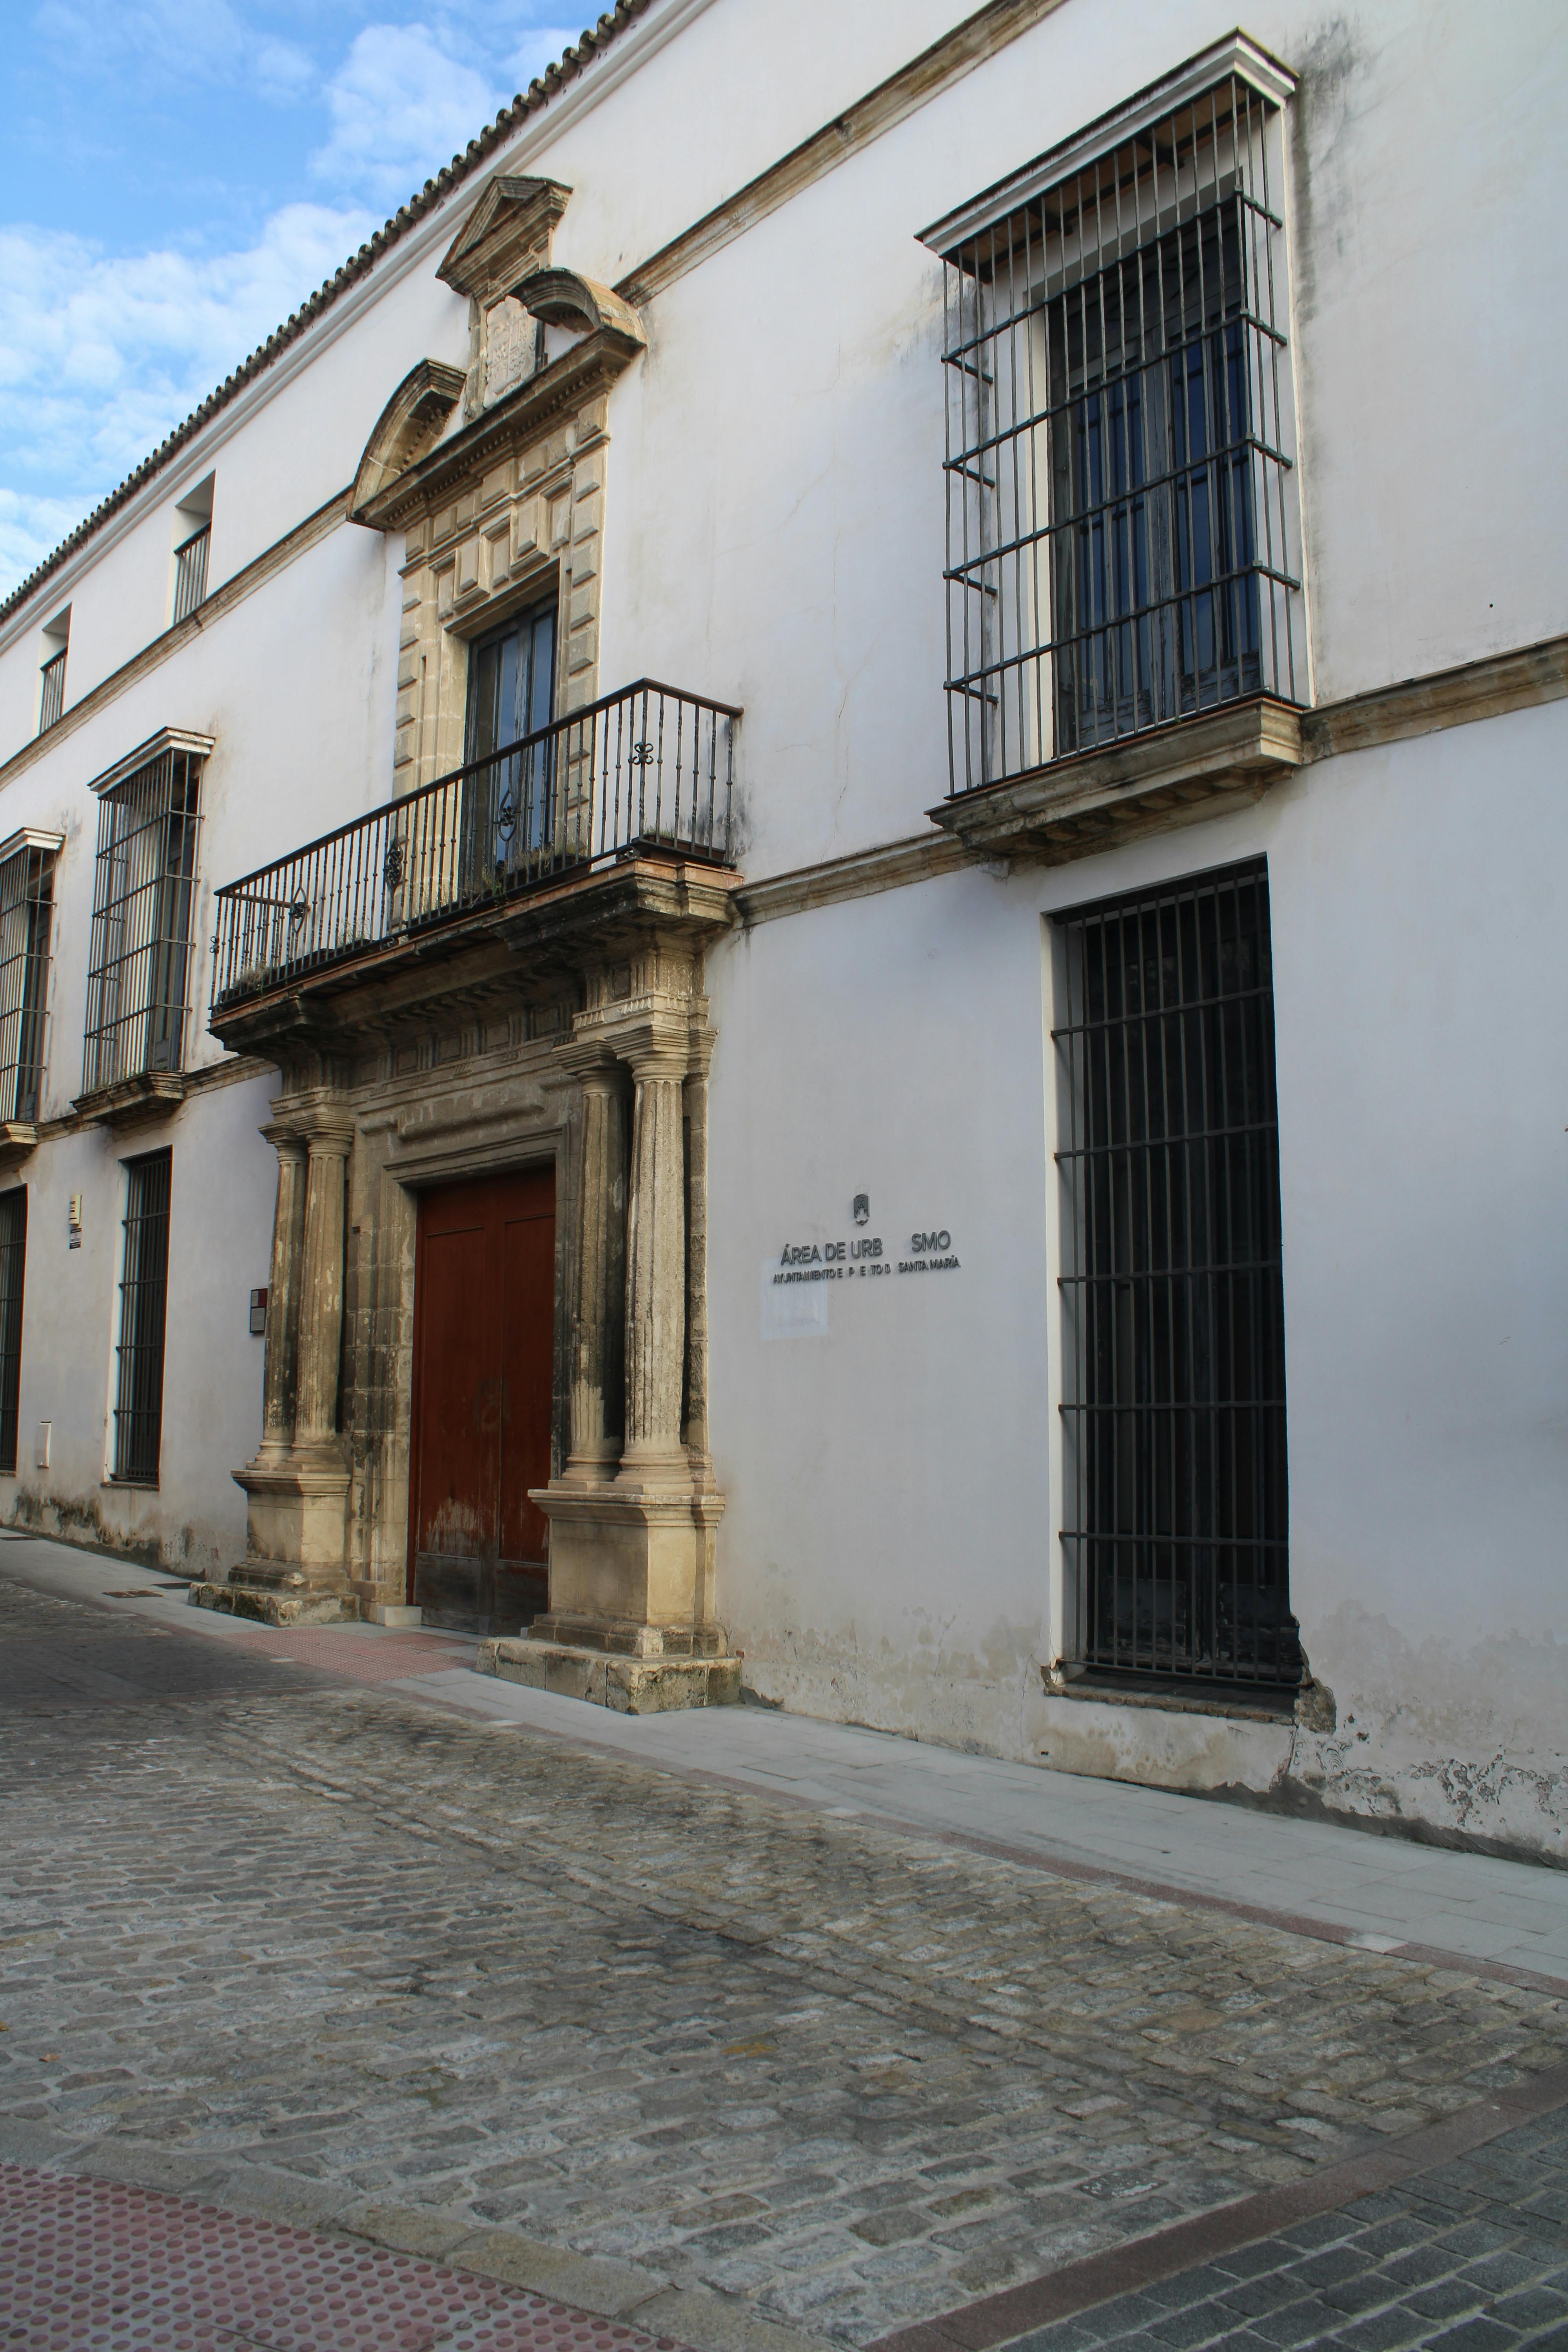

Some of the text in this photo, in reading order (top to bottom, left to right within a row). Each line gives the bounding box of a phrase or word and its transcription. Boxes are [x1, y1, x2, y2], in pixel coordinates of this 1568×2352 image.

[781, 1243, 822, 1265] ÁREA
[825, 1241, 846, 1261] DE
[773, 1268, 836, 1284] AYUNTAMIENTO
[898, 1259, 929, 1273] SANTA
[930, 1255, 961, 1270] MARÍA
